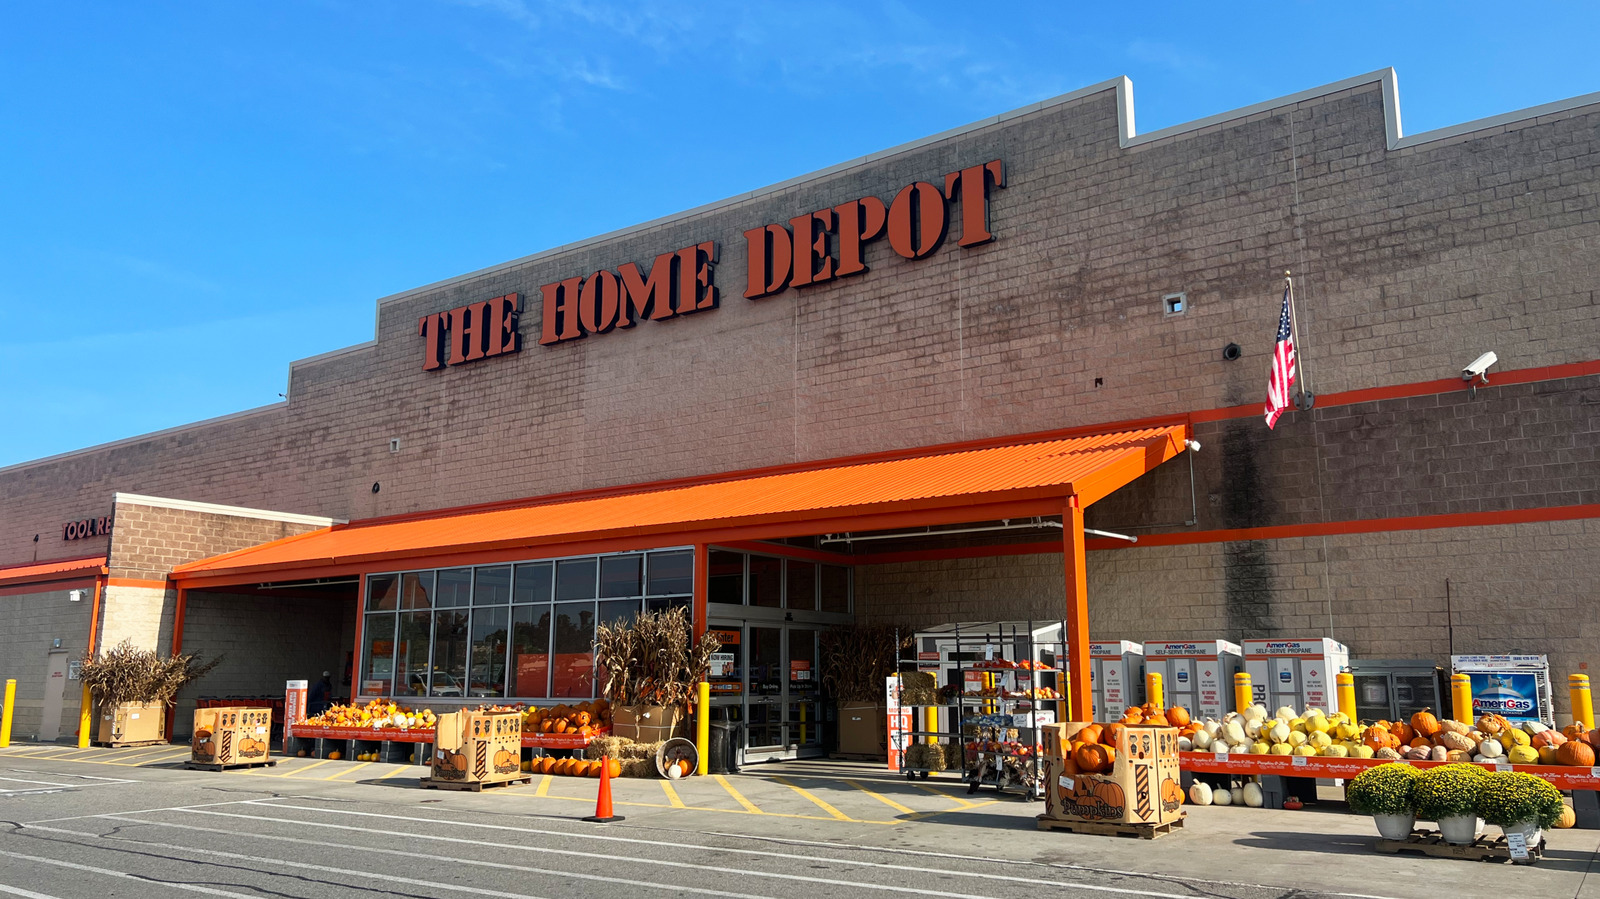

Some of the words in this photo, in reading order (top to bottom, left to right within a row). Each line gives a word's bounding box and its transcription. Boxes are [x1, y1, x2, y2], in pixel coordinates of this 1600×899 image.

[418, 293, 522, 372] THE
[538, 241, 719, 346] HOME
[743, 160, 1005, 300] DEPOT
[62, 519, 93, 541] TOOL
[1472, 699, 1530, 708] AmeriGas
[890, 716, 908, 728] HQ
[1061, 797, 1123, 819] Pumpkins
